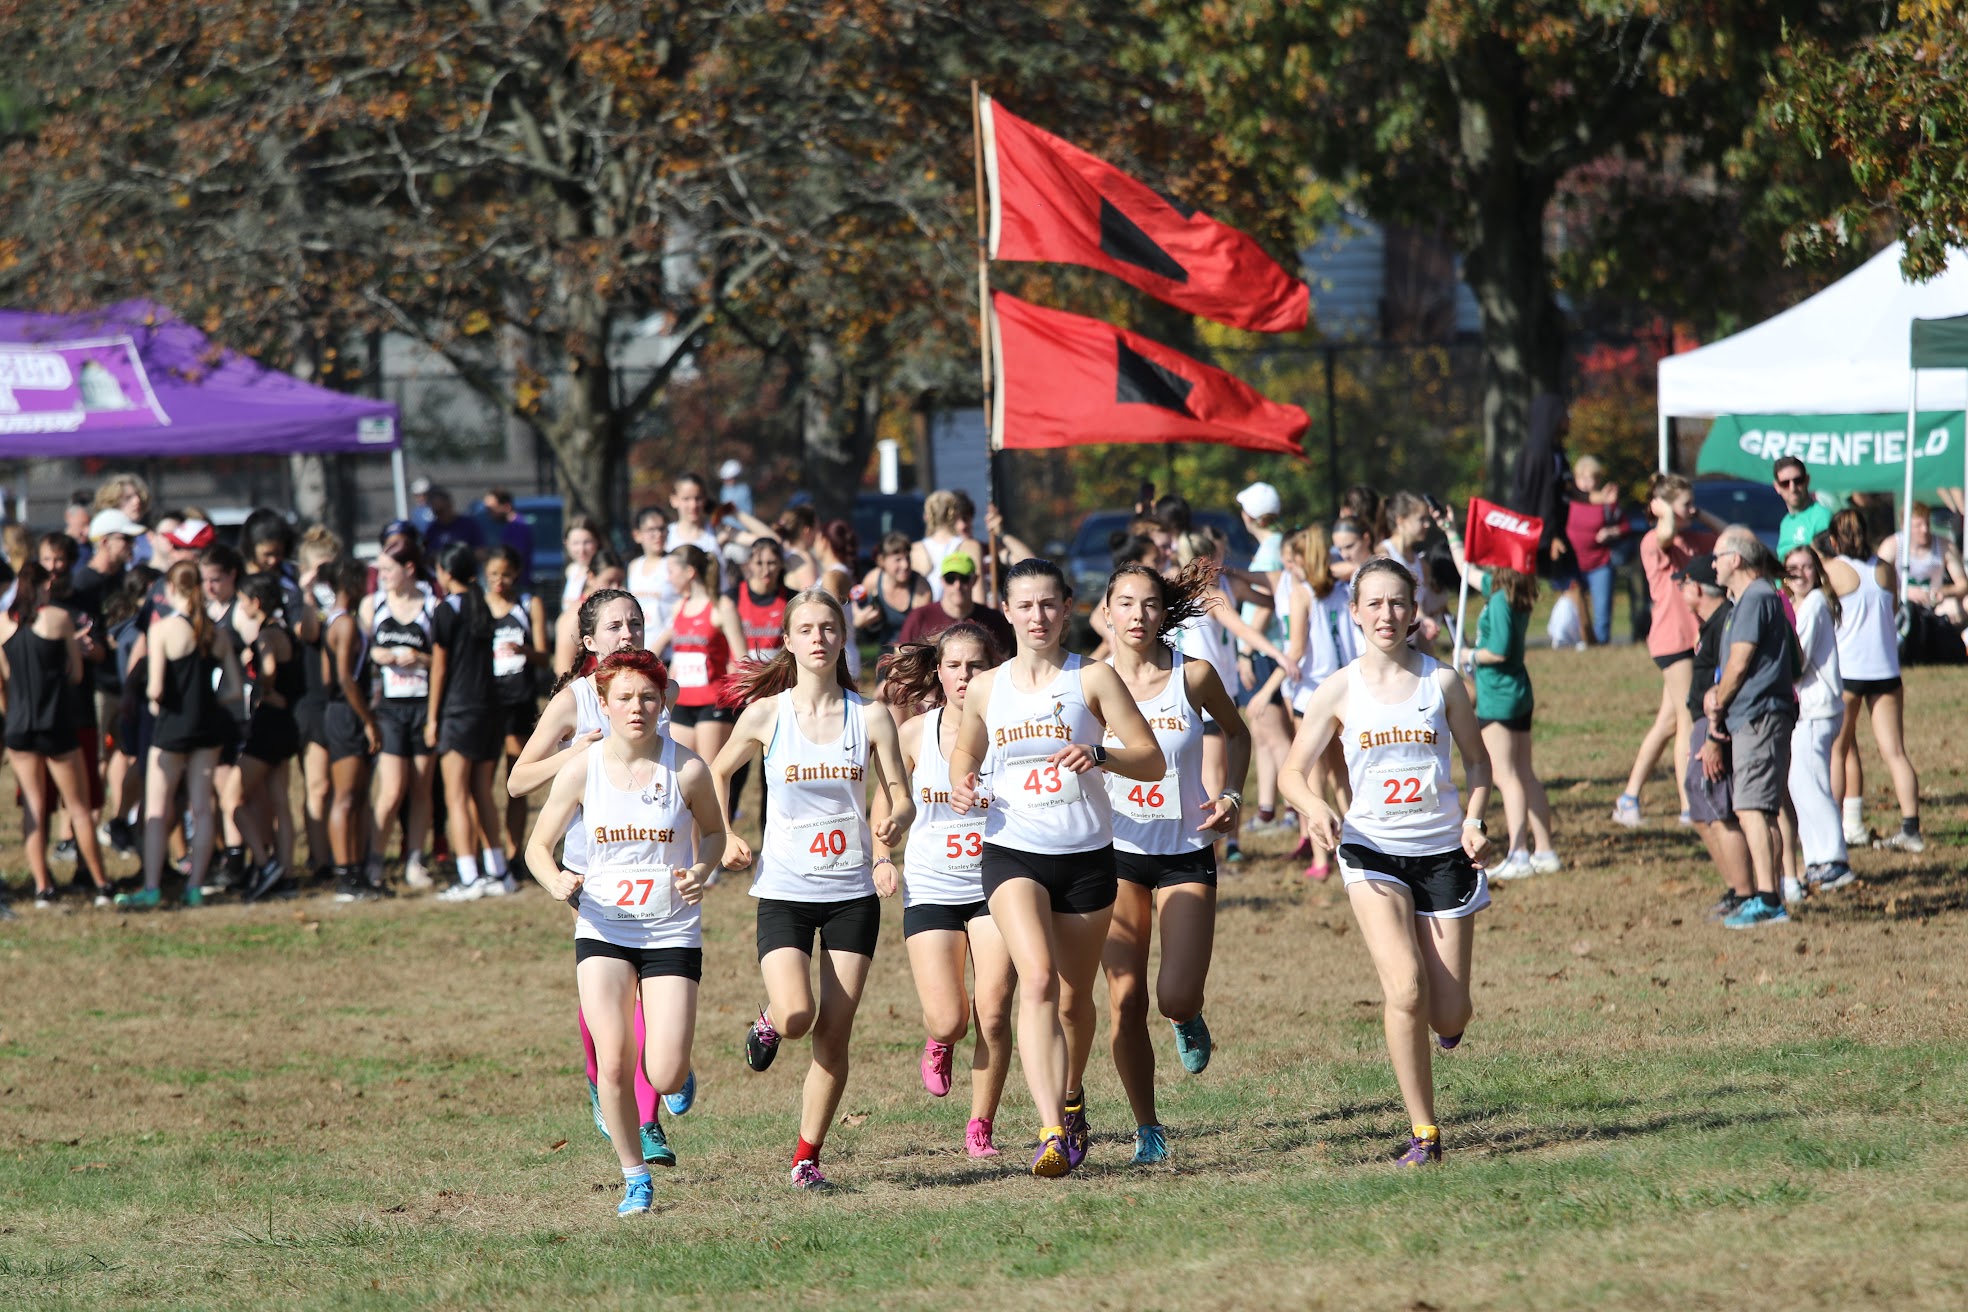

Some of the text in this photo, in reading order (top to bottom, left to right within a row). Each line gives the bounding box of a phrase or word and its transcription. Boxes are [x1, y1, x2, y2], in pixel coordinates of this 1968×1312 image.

[1484, 510, 1530, 536] GILL
[995, 721, 1073, 749] Amherst
[1359, 725, 1438, 750] Amherst
[785, 762, 864, 784] Amherst
[1023, 766, 1062, 795] 43
[1127, 784, 1165, 808] 46
[1383, 777, 1423, 804] 22
[1027, 801, 1050, 809] Stanley
[595, 824, 675, 844] Amherst
[809, 829, 847, 857] 40
[946, 832, 983, 858] 53
[814, 864, 835, 872] Stanley
[616, 879, 655, 906] 27
